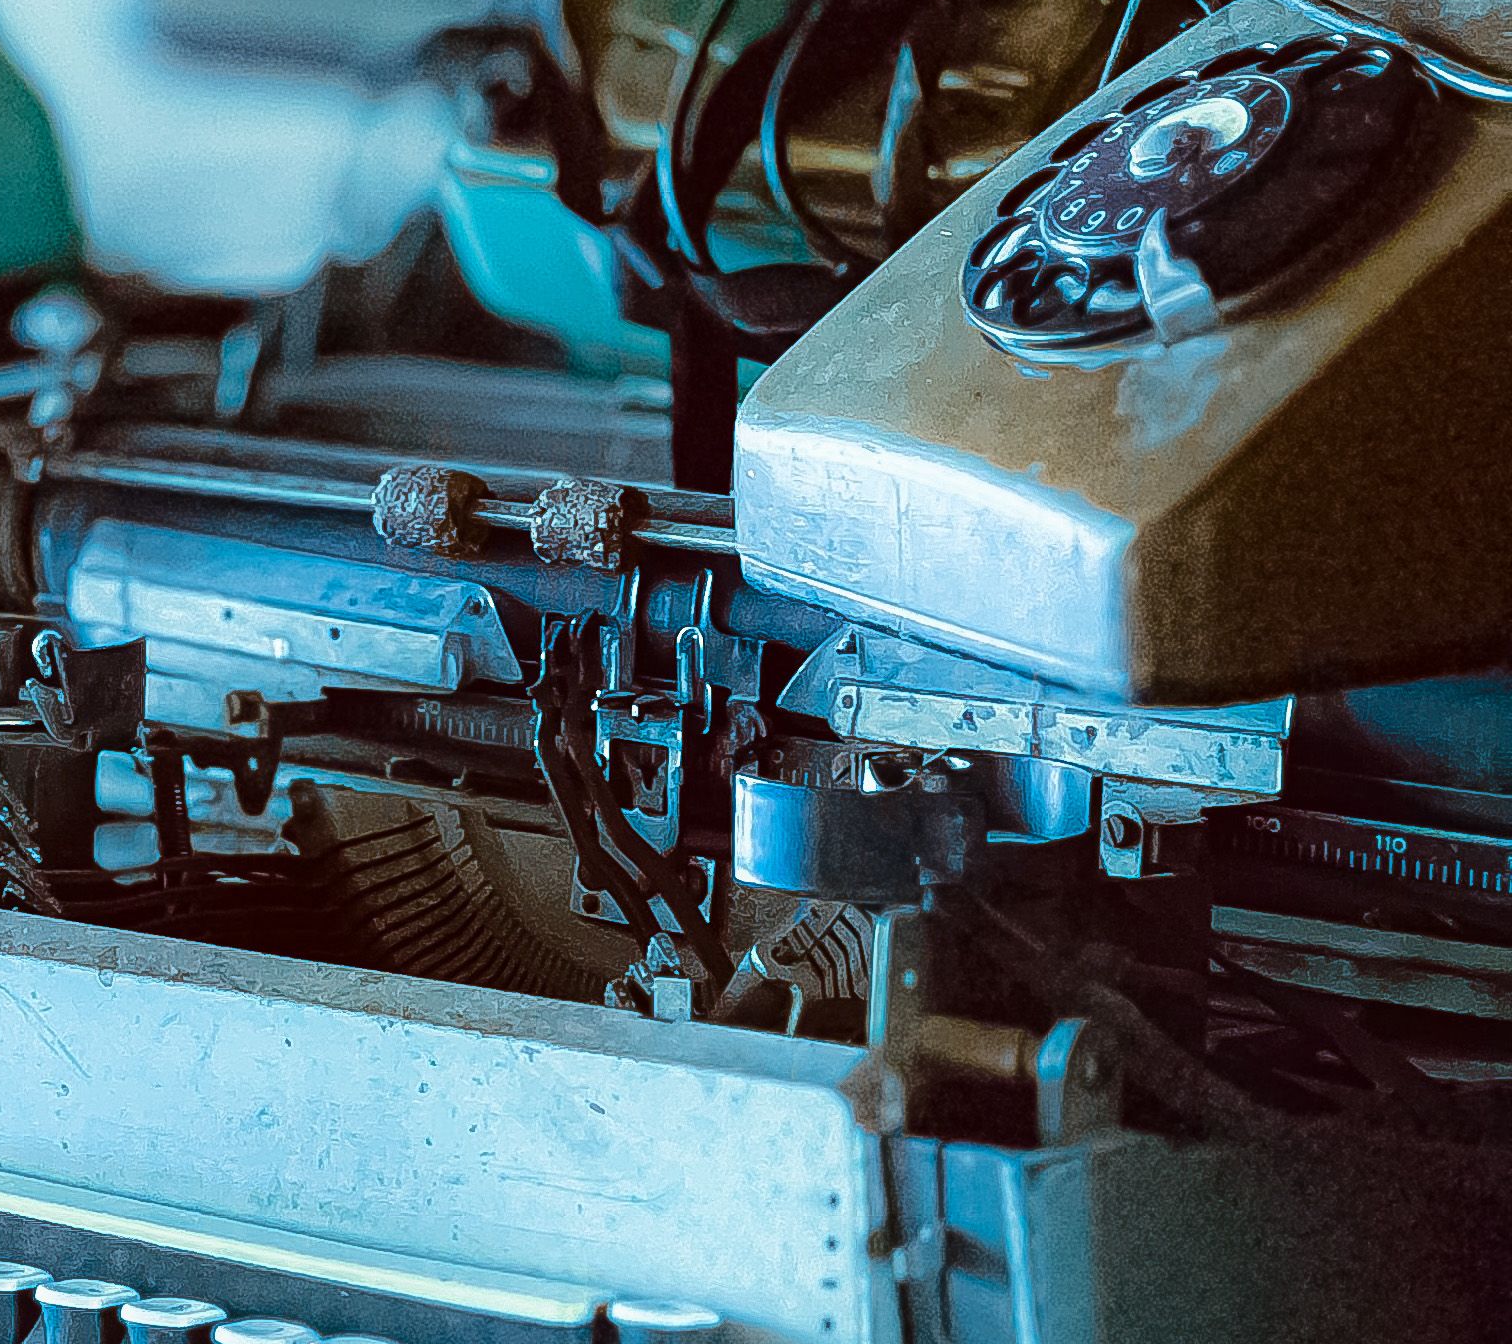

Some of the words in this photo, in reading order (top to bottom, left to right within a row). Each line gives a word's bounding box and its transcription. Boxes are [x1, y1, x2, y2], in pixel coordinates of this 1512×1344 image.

[1222, 80, 1251, 98] 2
[1248, 89, 1272, 108] 1
[1103, 122, 1135, 143] 5
[1072, 152, 1098, 173] 6
[1051, 179, 1085, 203] 7
[1060, 198, 1087, 221] 8
[1116, 206, 1145, 231] 0
[1081, 210, 1106, 233] 9
[1246, 816, 1281, 833] 100
[1375, 834, 1407, 854] 110
